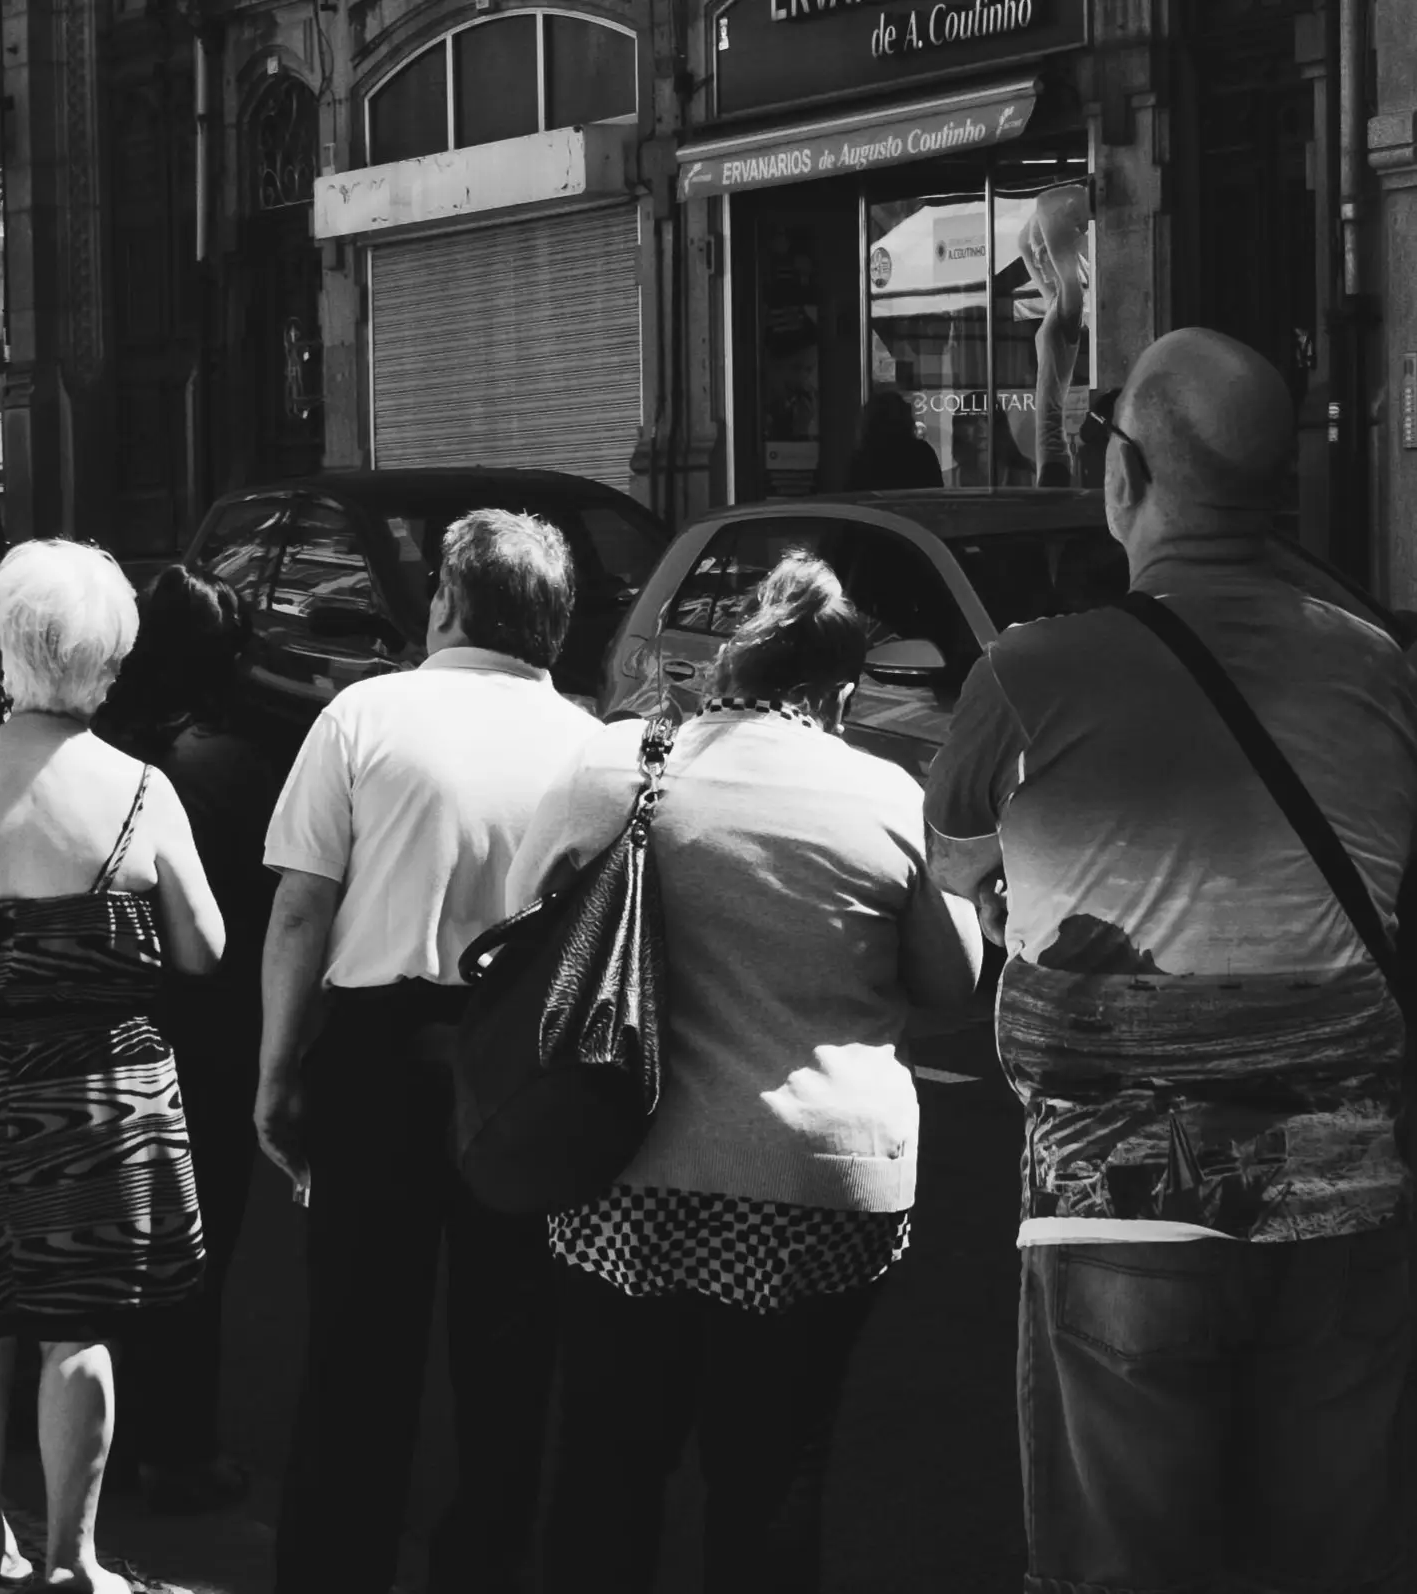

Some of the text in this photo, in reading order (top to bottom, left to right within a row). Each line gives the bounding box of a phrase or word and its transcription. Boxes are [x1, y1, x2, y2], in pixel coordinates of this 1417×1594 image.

[871, 12, 896, 58] de
[904, 10, 923, 50] A.
[929, 0, 1032, 46] Coutinho
[721, 118, 986, 185] ERVANARIOS de Augusto Coutinho
[930, 393, 1037, 412] COLLITAR
